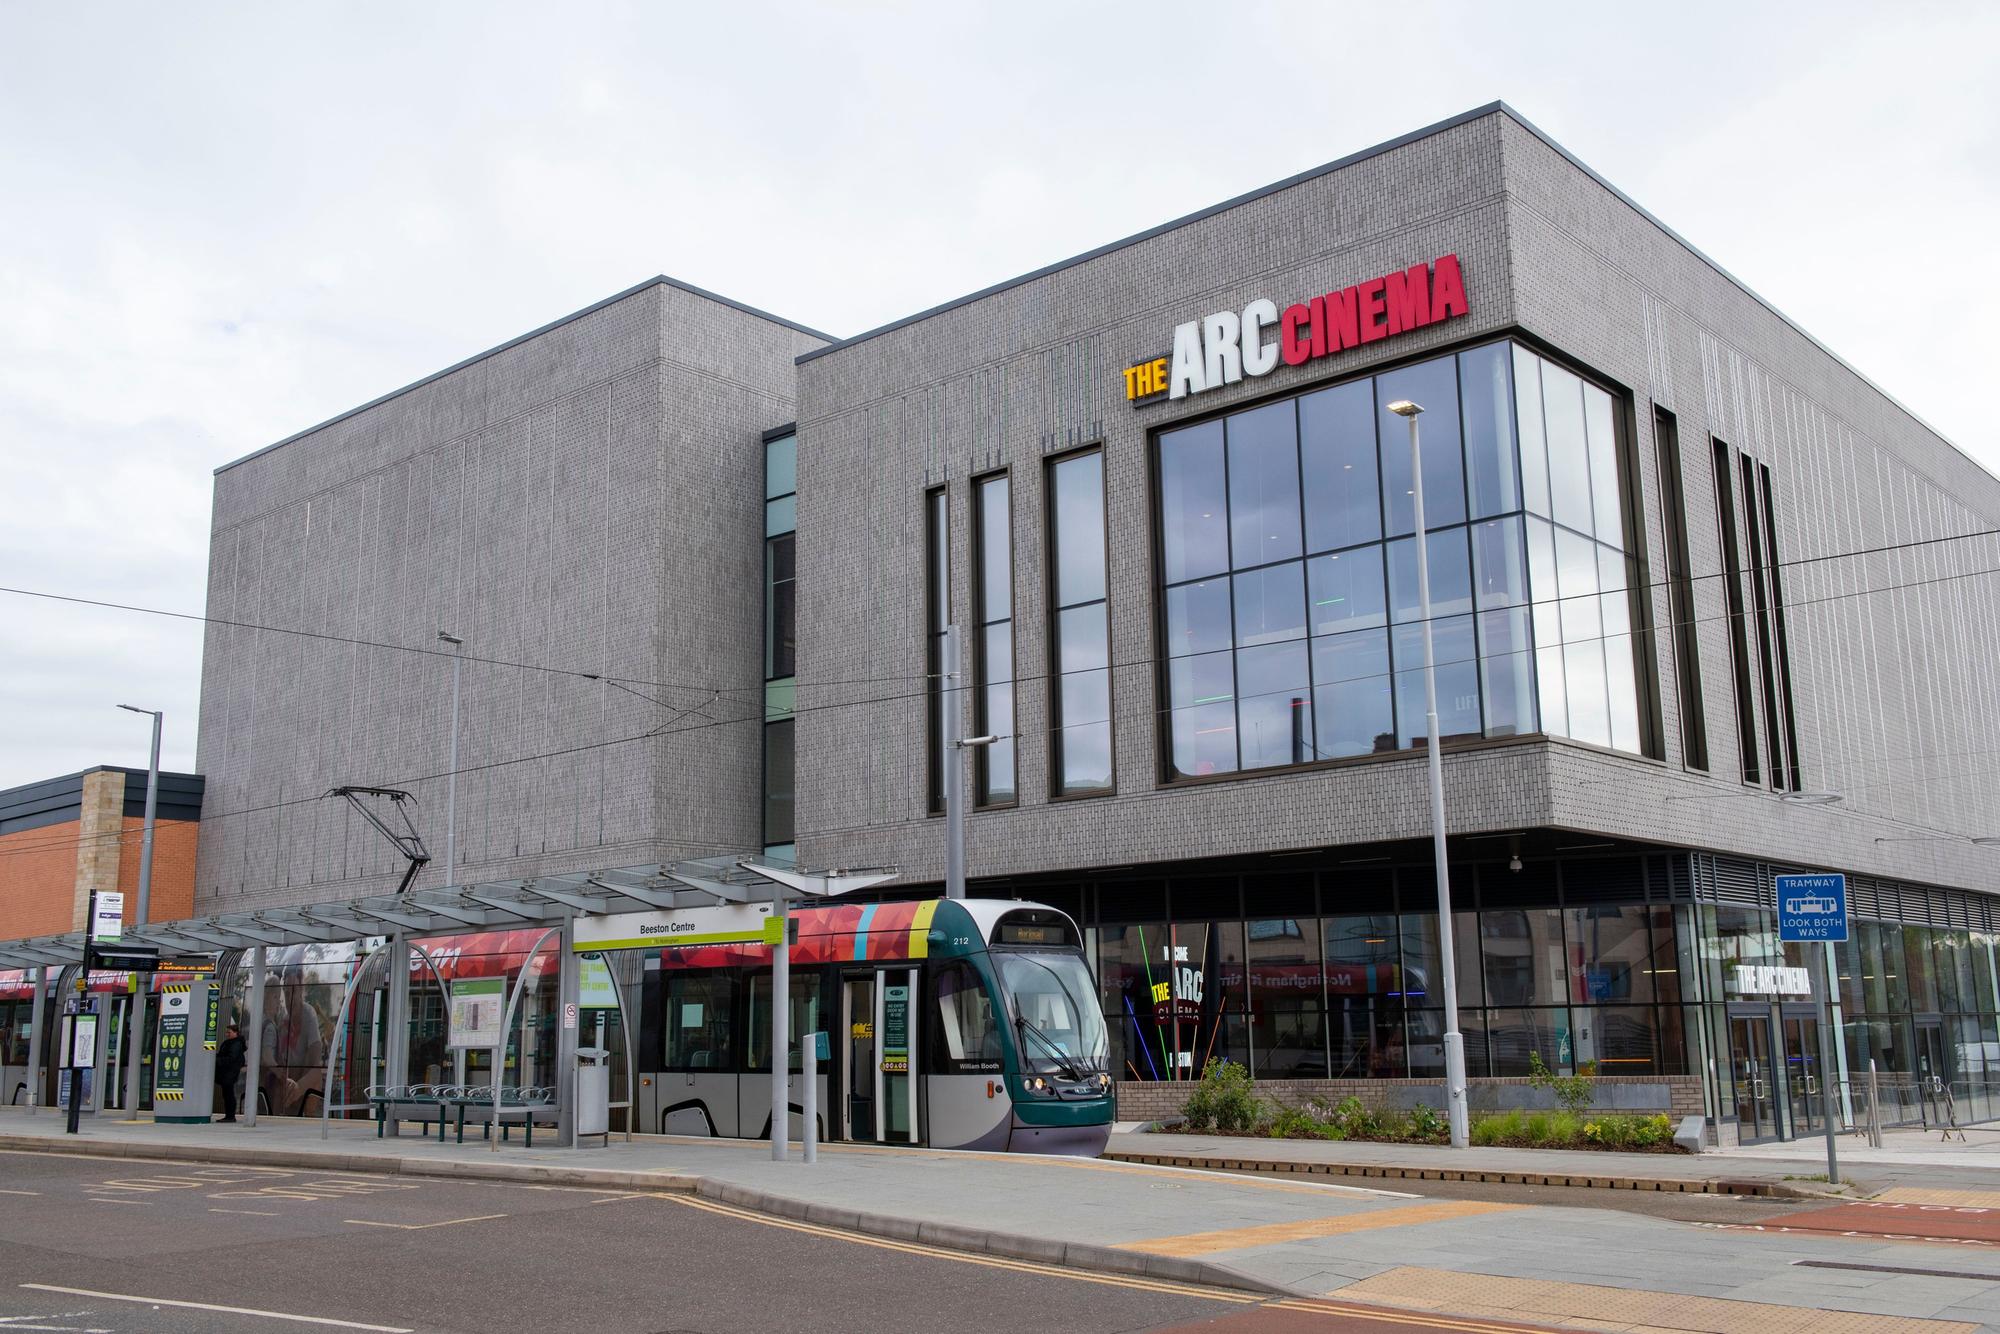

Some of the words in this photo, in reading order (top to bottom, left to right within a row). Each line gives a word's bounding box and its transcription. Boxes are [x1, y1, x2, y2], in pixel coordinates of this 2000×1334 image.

[1122, 357, 1169, 402] THE
[1168, 298, 1280, 401] ARC
[1280, 253, 1470, 367] CINEMA
[1455, 695, 1478, 711] LIFT
[1783, 878, 1837, 889] TRAMWAY
[640, 924, 670, 935] Beeston
[670, 922, 696, 932] Centre
[1782, 918, 1811, 928] LOOK
[1813, 917, 1843, 928] BOTH
[1798, 928, 1828, 937] WAYS
[372, 938, 379, 947] A
[953, 937, 969, 946] 212
[1163, 946, 1189, 961] WCOME
[1174, 967, 1204, 1003] ARC
[1735, 965, 1757, 993] THE
[1756, 966, 1777, 994] ARC
[1776, 966, 1811, 994] CINEMA
[1151, 982, 1170, 1003] THE
[1158, 1006, 1199, 1021] CIEMA
[980, 1062, 1000, 1070] Booth
[206, 1179, 421, 1201] BUS
